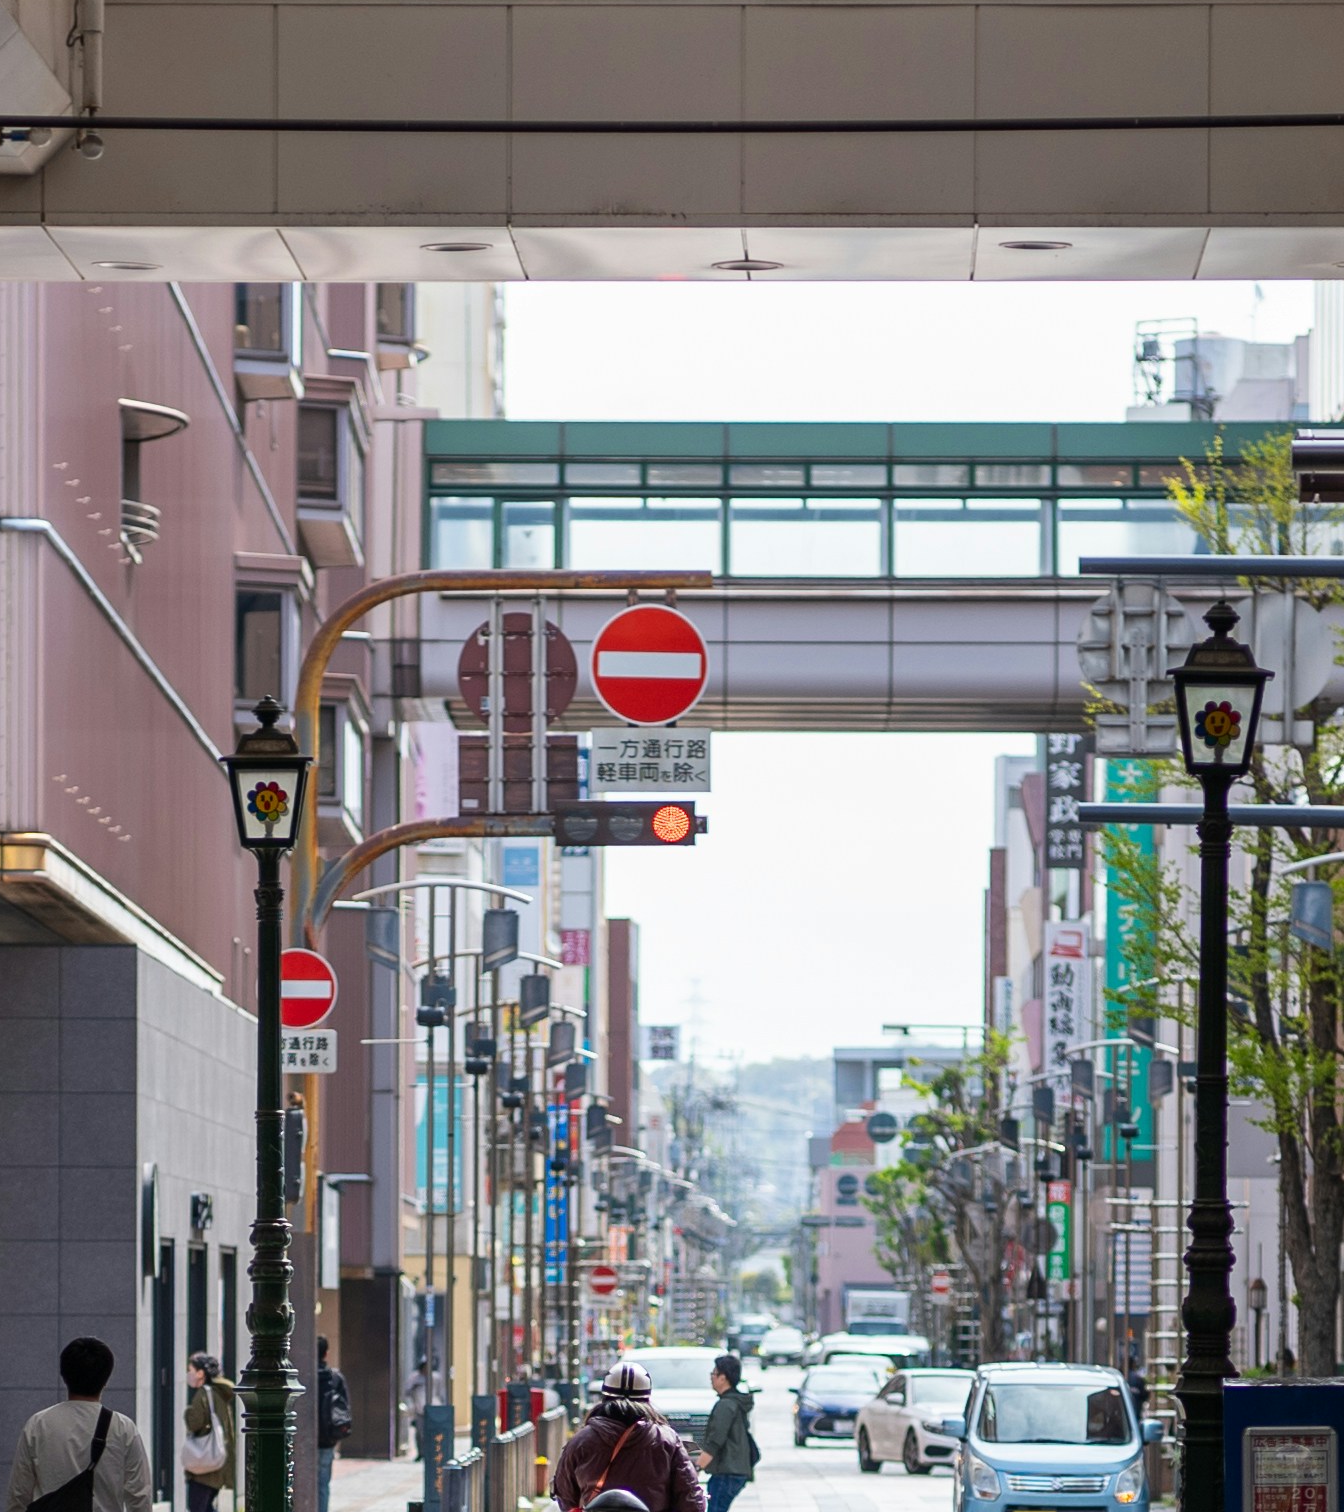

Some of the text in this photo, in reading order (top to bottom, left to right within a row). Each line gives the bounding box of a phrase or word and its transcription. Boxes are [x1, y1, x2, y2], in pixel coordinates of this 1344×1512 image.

[598, 739, 707, 759] 一方通行路
[597, 762, 707, 783] 軽車両を除く
